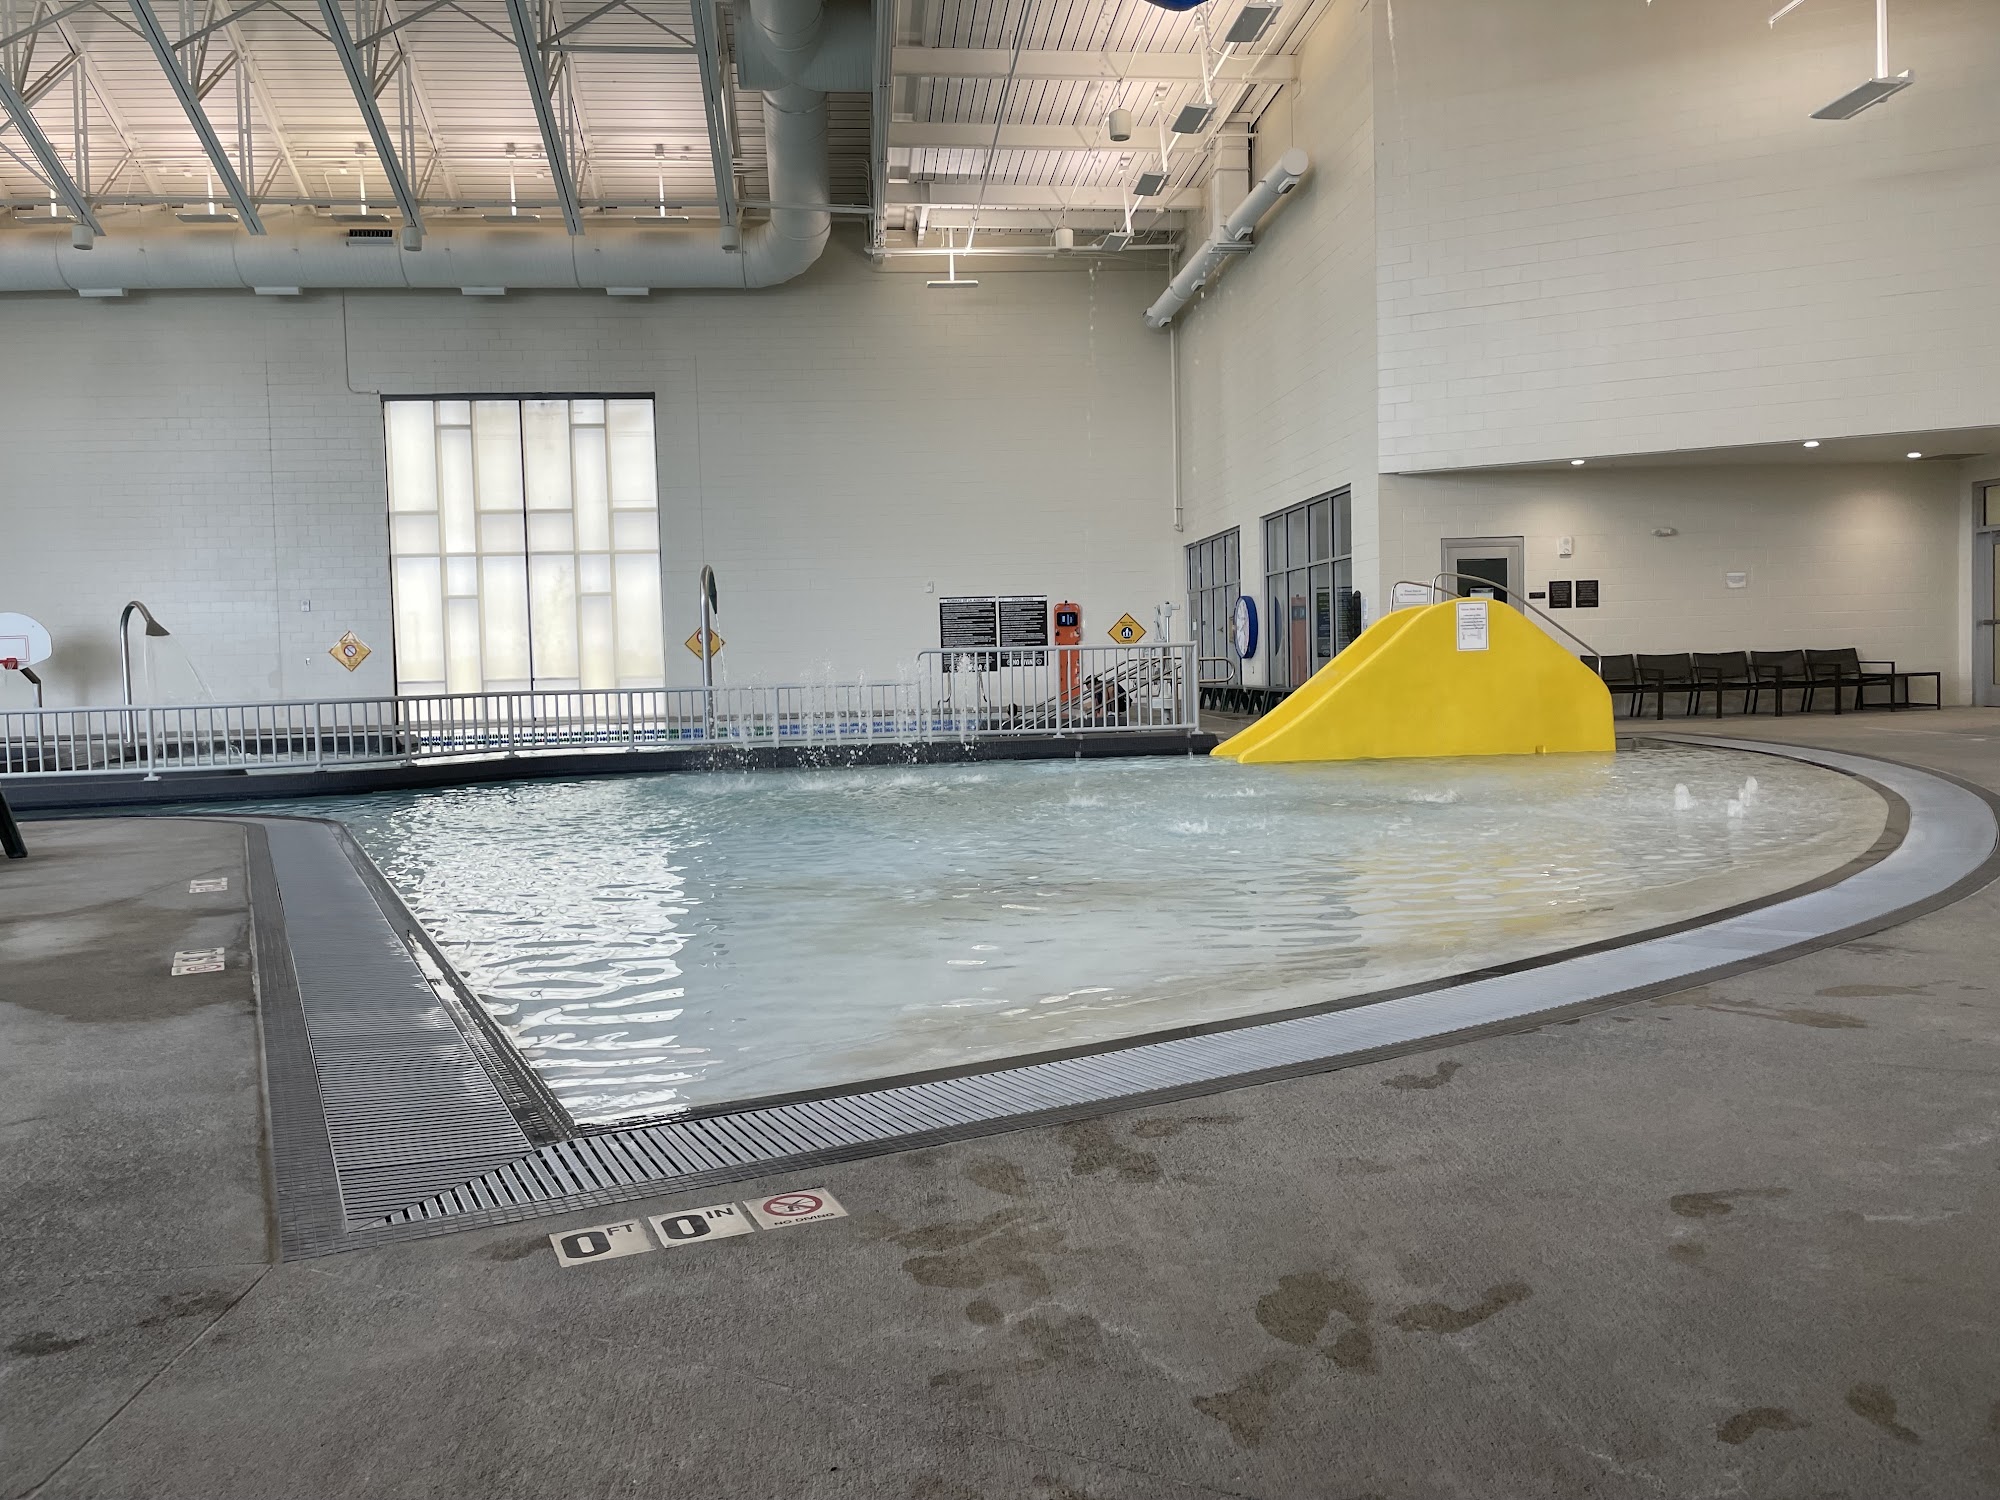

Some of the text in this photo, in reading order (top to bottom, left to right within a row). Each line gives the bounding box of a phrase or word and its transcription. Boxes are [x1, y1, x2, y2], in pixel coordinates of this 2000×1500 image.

[661, 1208, 734, 1240] 0 IN
[795, 1212, 835, 1222] DIVING
[561, 1223, 634, 1258] 0 FT
